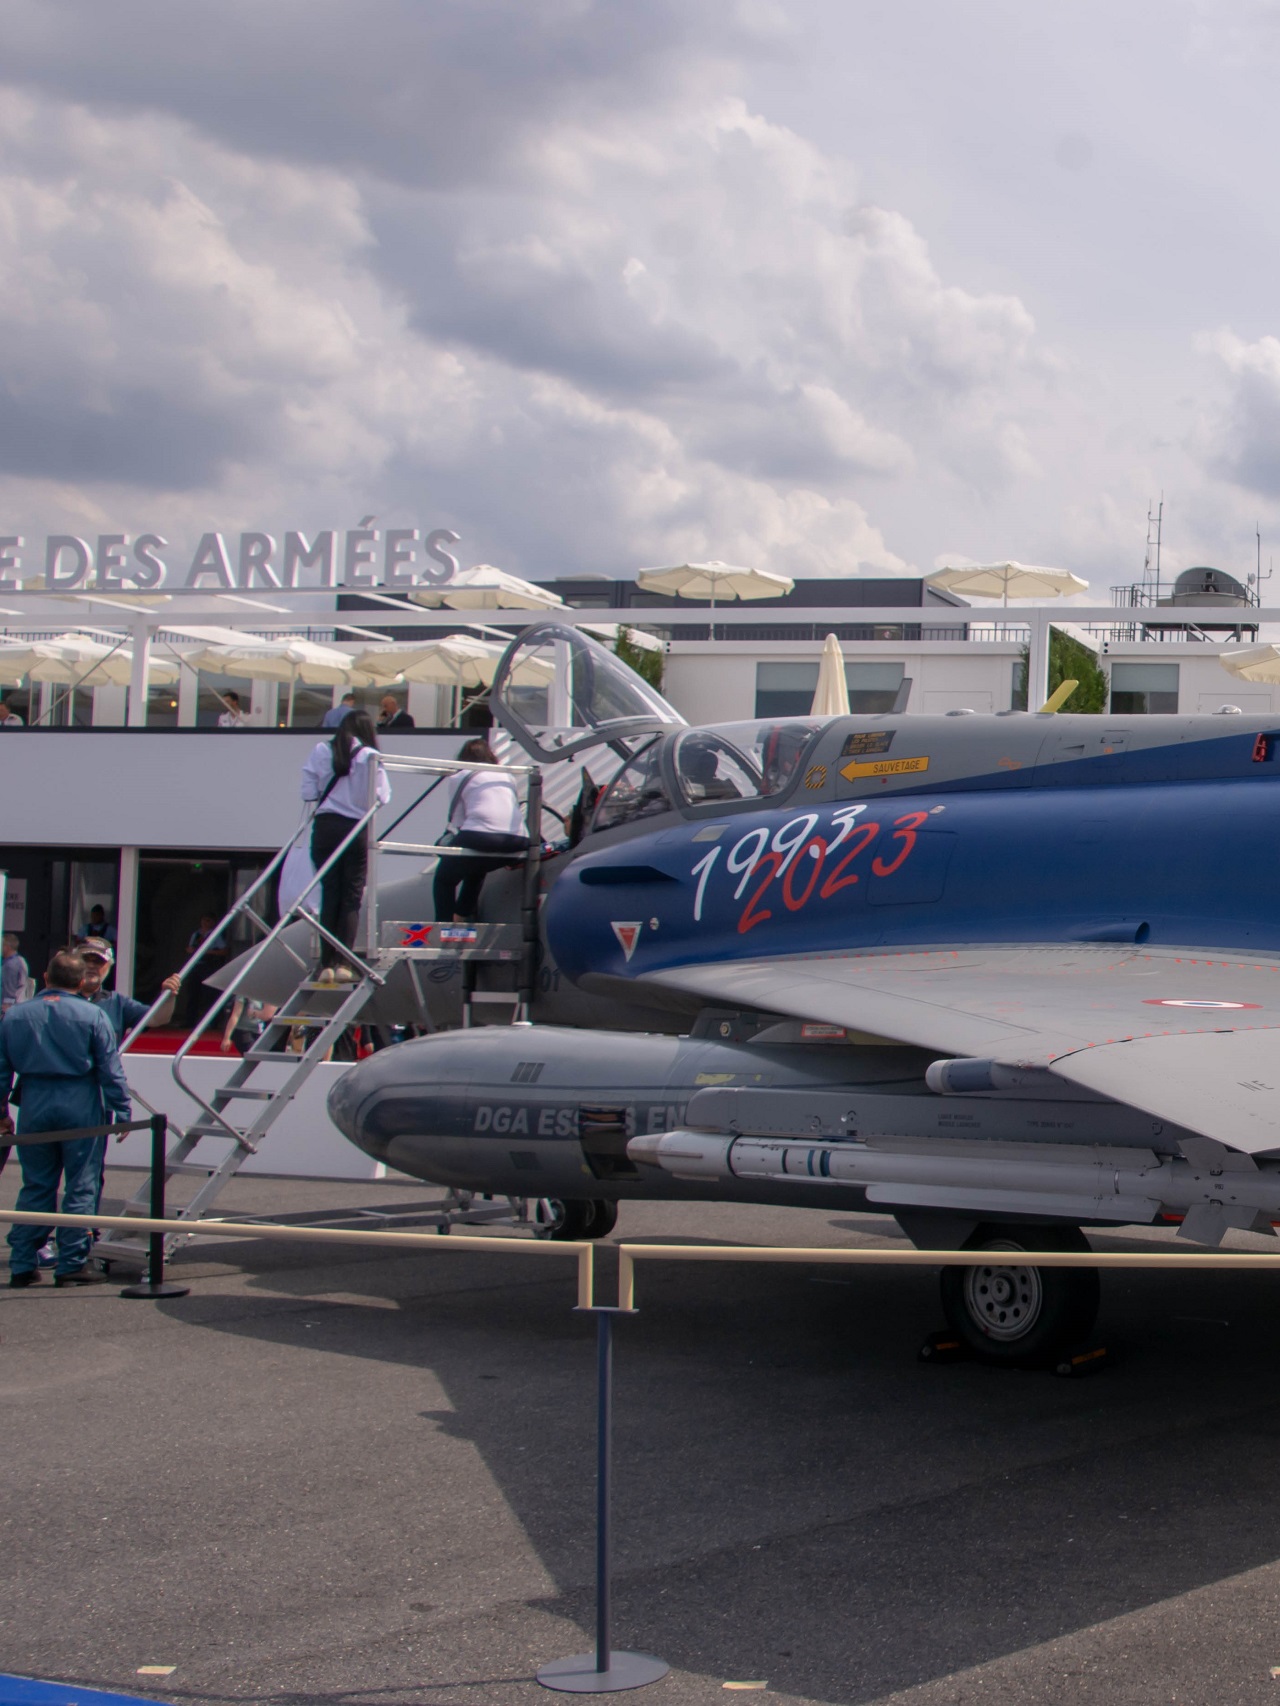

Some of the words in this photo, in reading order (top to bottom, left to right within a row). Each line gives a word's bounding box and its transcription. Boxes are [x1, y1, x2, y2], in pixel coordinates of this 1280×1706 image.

[45, 533, 168, 590] DES
[185, 515, 461, 588] ARMÉES
[873, 760, 920, 774] SAUVETAGE
[691, 804, 868, 921] 1993
[737, 811, 929, 934] 2023
[474, 1106, 529, 1134] DGA
[647, 1106, 687, 1135] EN
